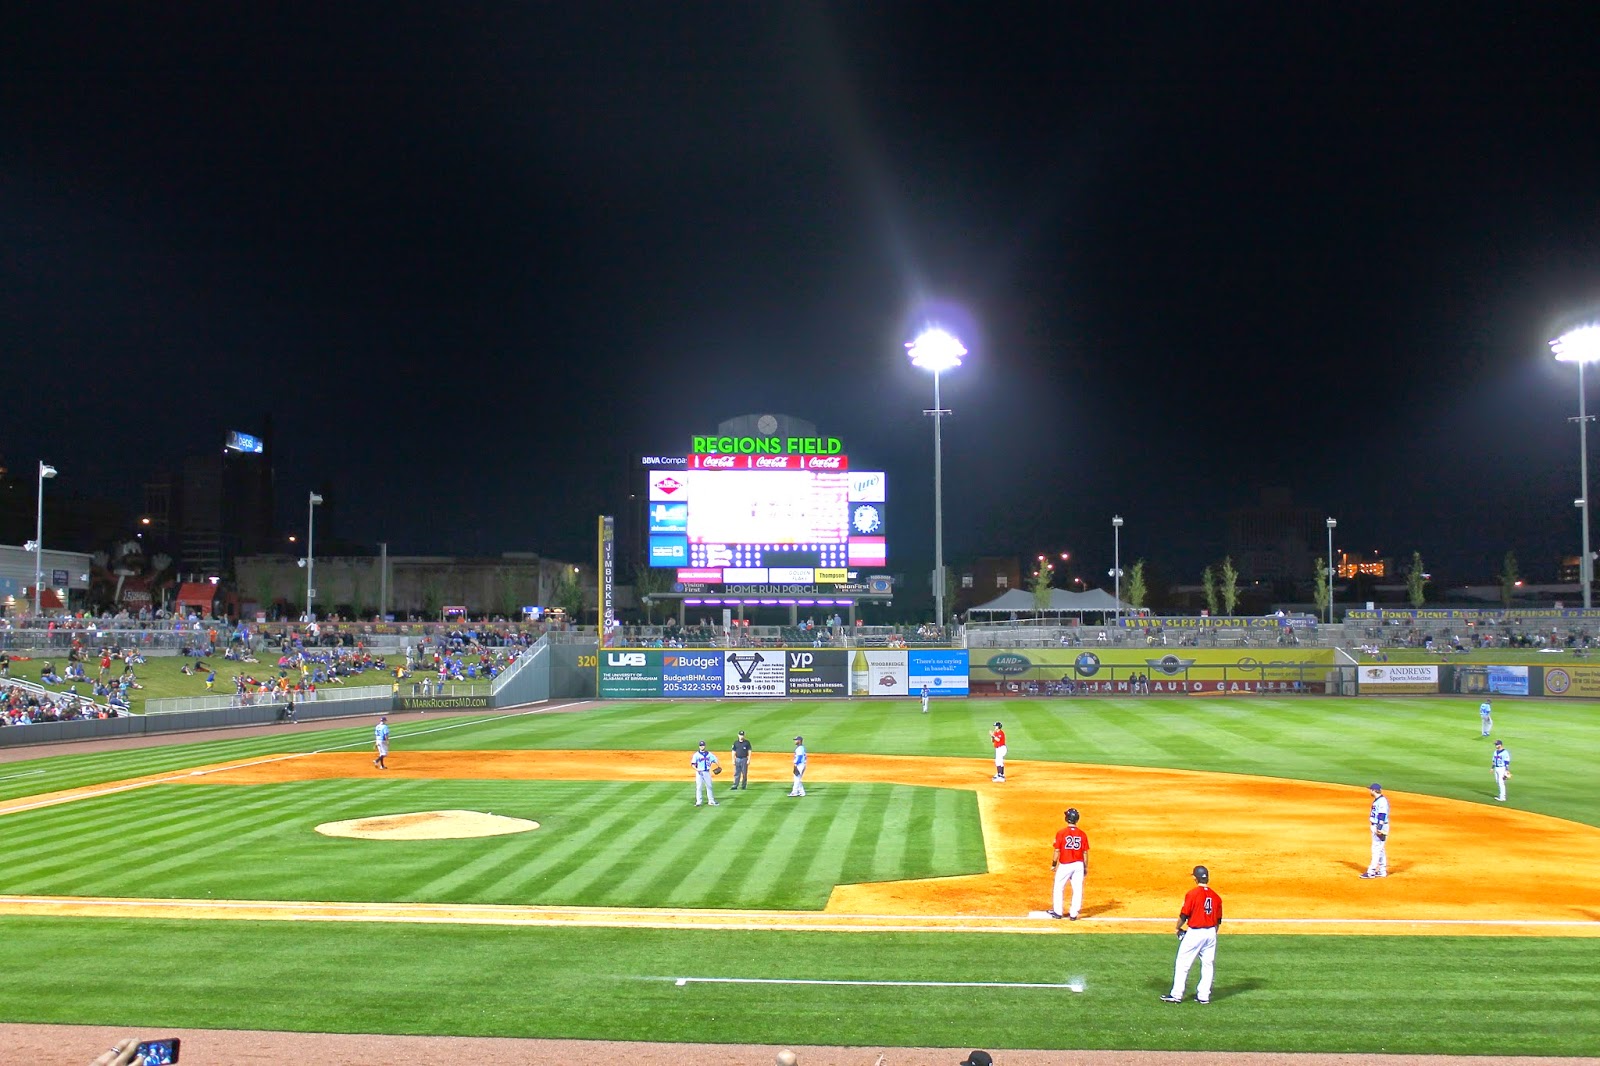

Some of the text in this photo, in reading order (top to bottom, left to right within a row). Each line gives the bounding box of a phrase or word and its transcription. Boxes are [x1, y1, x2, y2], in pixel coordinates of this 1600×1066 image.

[693, 437, 842, 454] REGIONS FIELD
[725, 585, 819, 594] HOME RUN PORCH
[577, 655, 597, 667] 320
[608, 653, 647, 666] UAB
[679, 656, 719, 669] Budget
[790, 652, 814, 668] yp
[663, 674, 722, 682] BudgetBHM.com
[663, 683, 722, 691] 205-322-3596
[1154, 682, 1203, 690] AUTO
[1065, 836, 1082, 850] 25
[1203, 897, 1213, 915] 4
